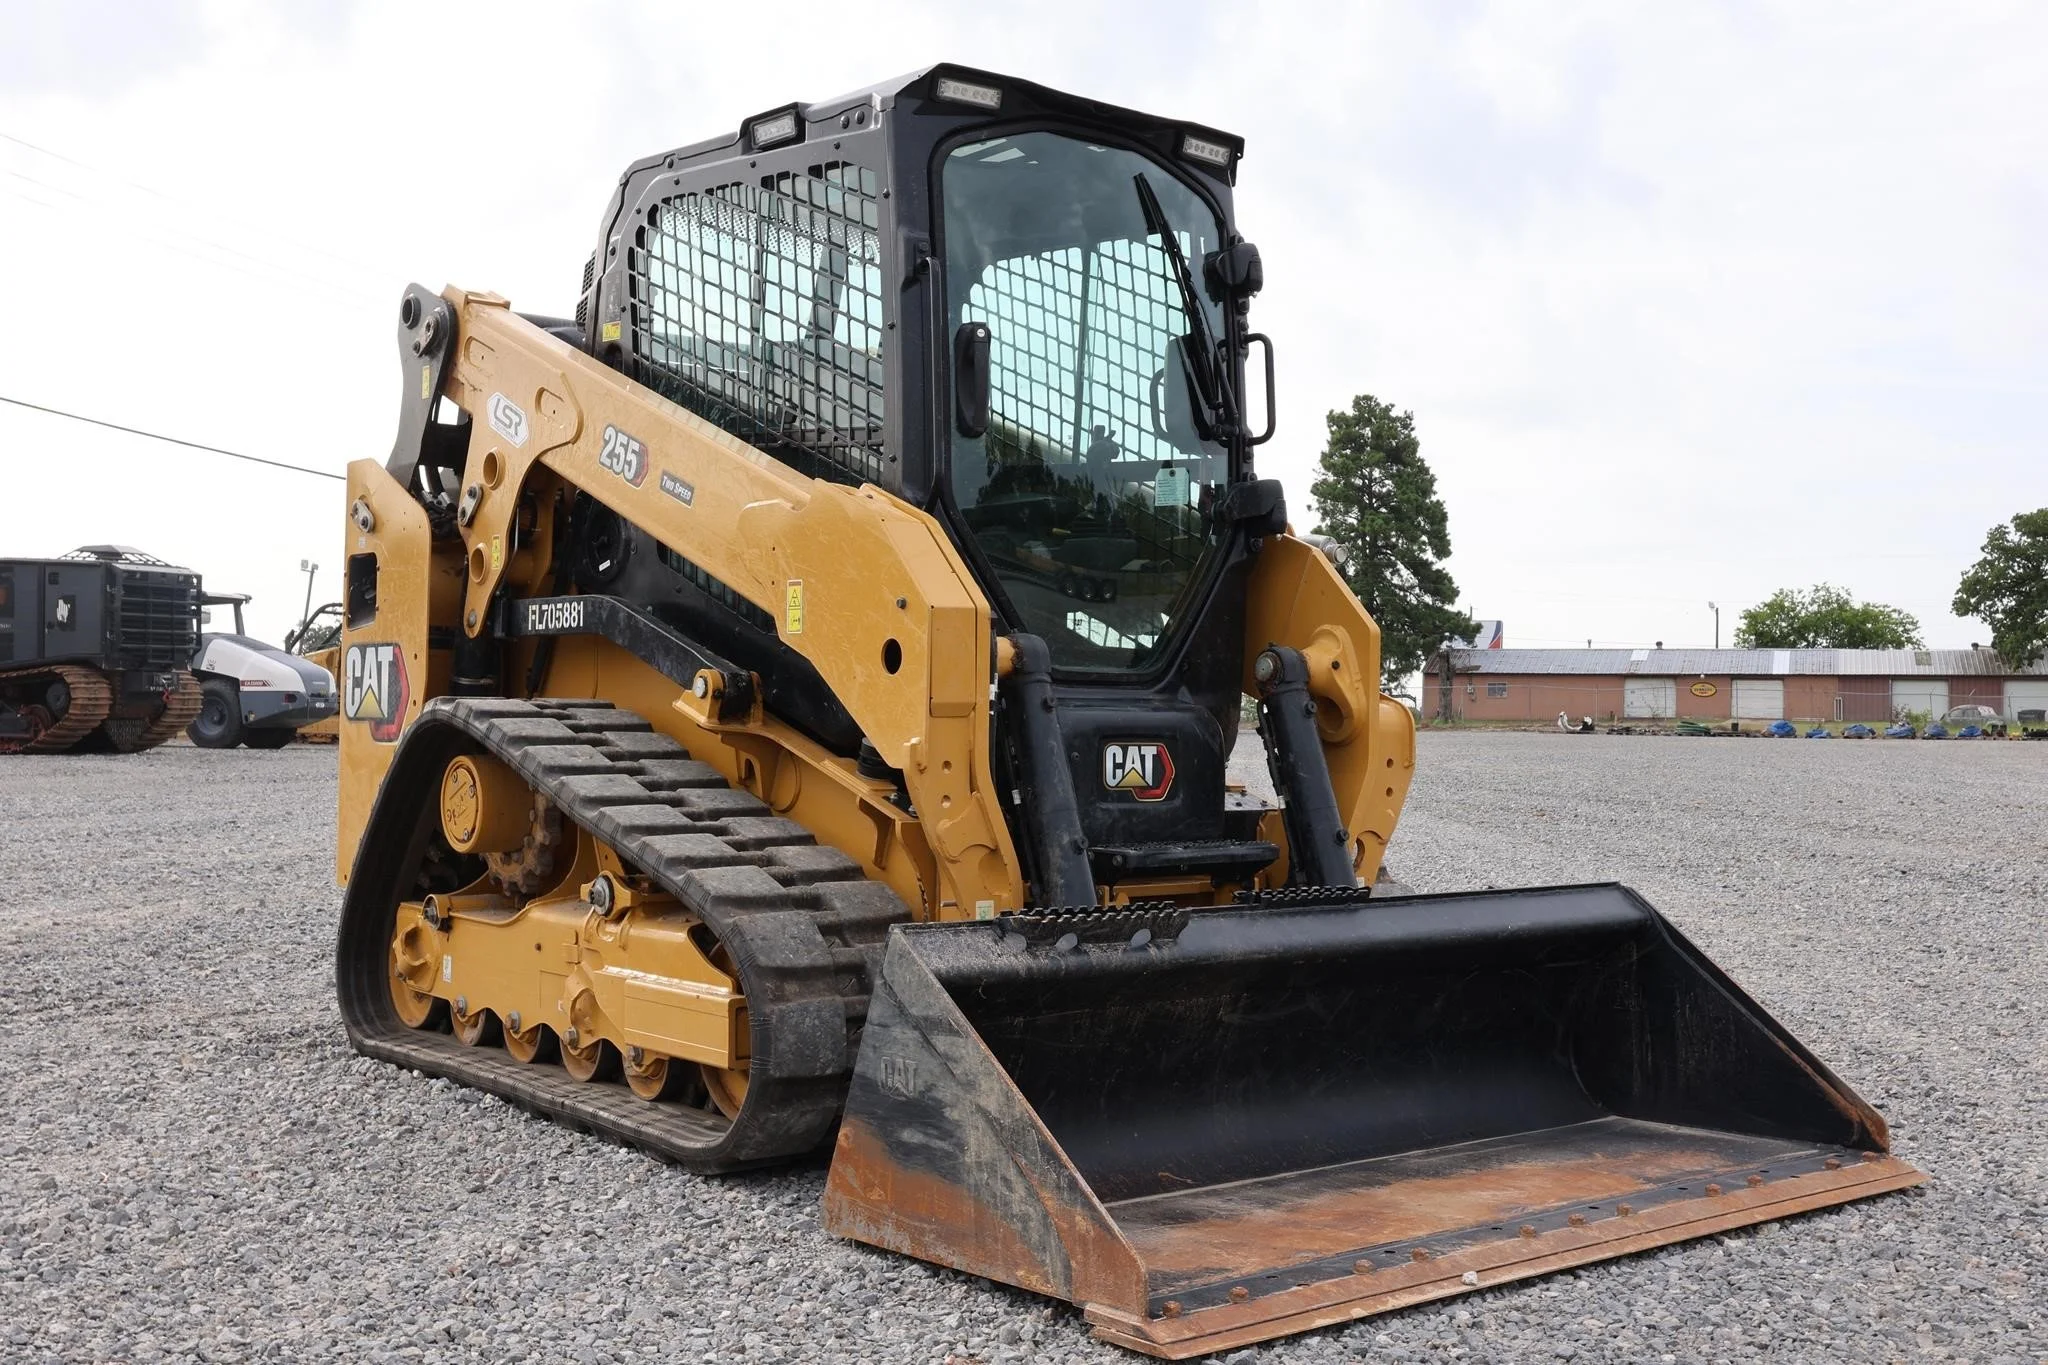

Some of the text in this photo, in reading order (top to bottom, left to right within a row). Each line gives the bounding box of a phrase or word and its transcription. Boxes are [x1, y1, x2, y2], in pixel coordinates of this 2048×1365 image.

[600, 426, 640, 480] 255
[528, 601, 584, 630] FL705881
[346, 646, 393, 718] CAT
[1105, 745, 1157, 787] CAT
[881, 1056, 919, 1097] CAT
